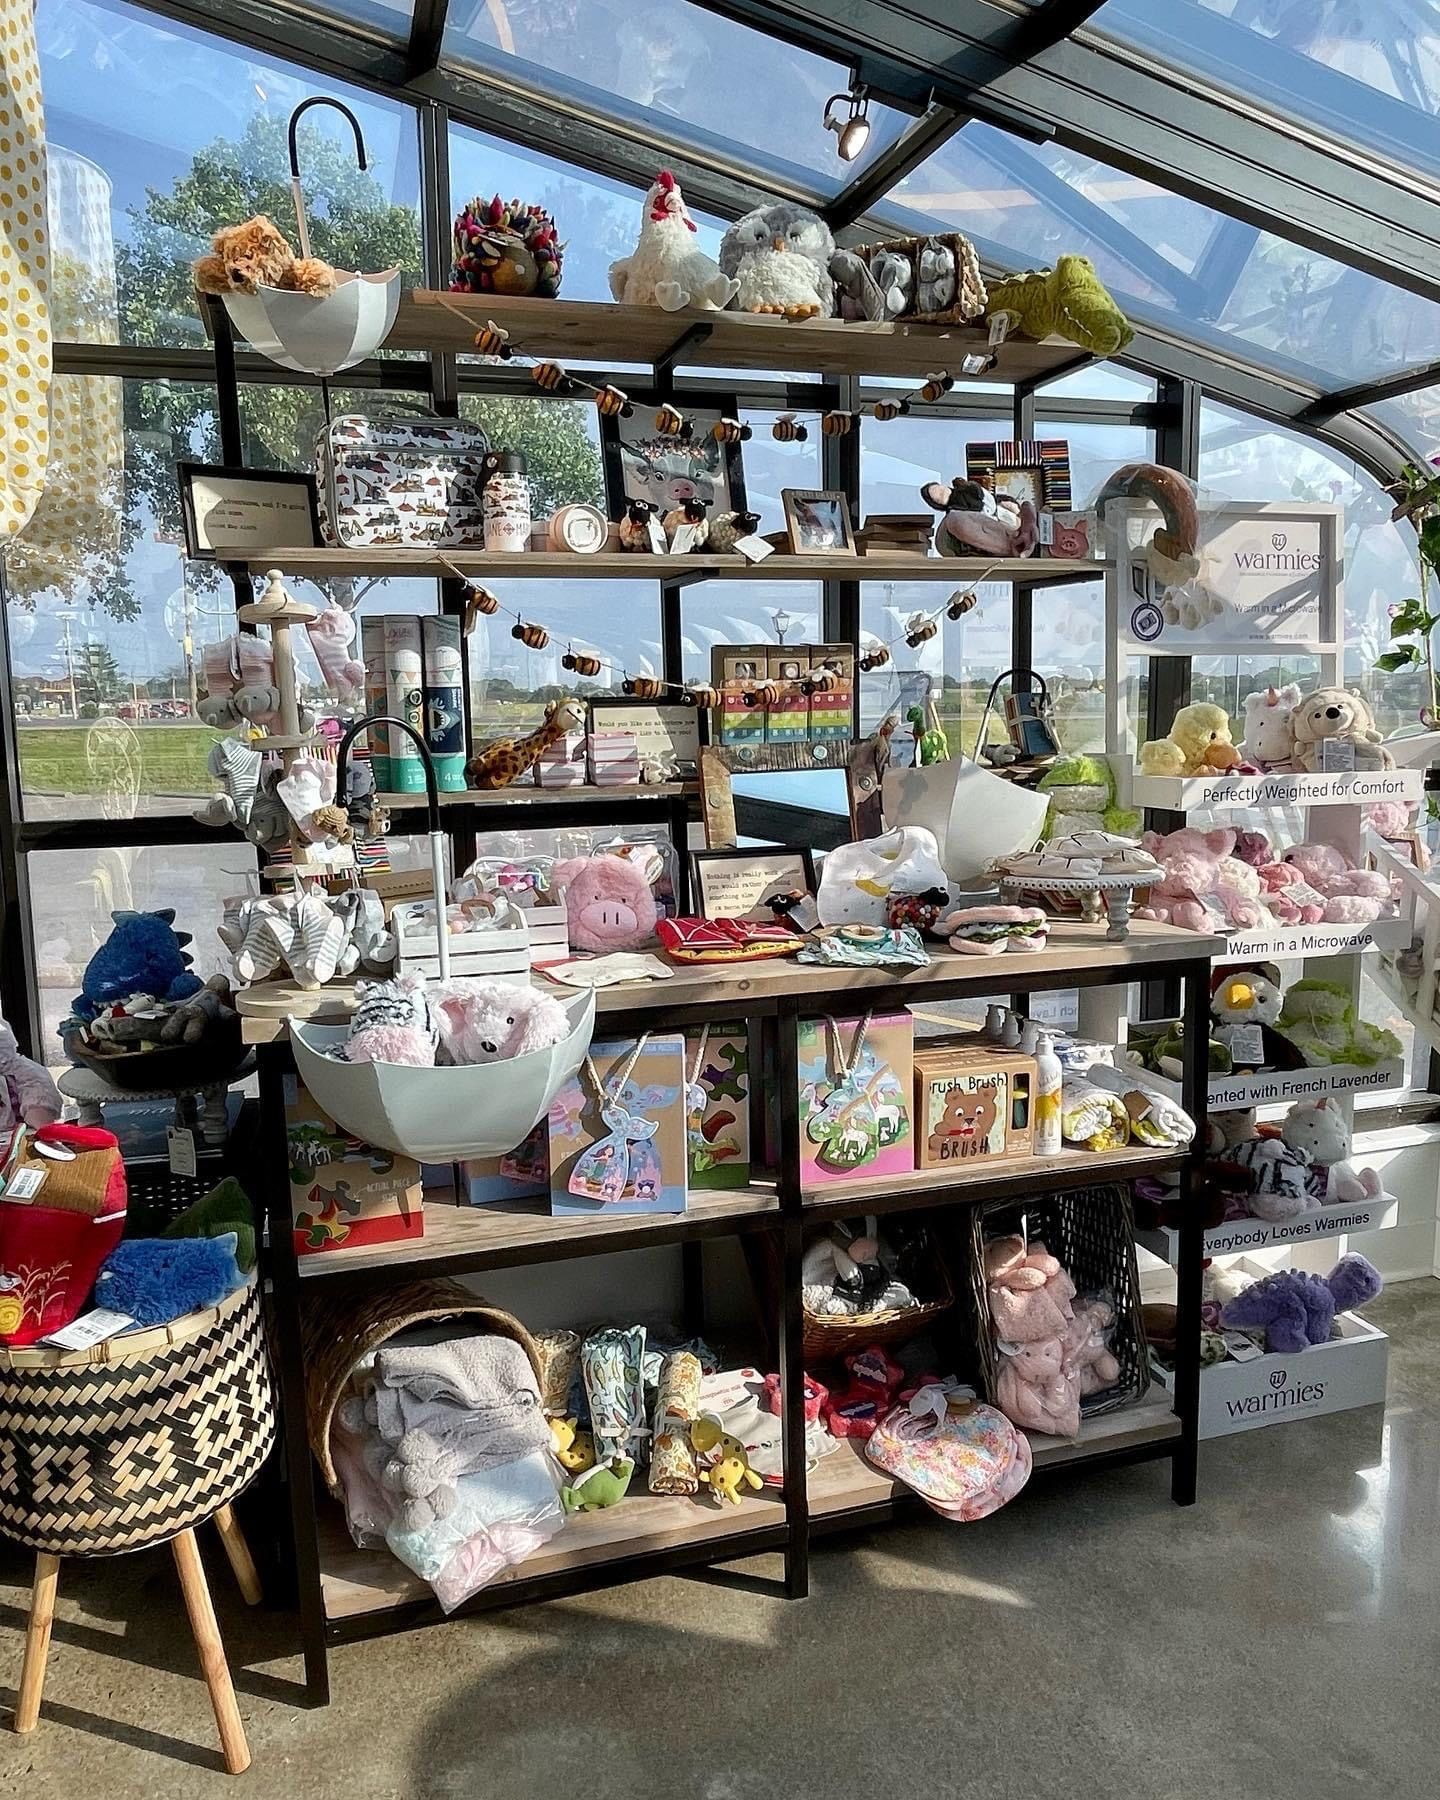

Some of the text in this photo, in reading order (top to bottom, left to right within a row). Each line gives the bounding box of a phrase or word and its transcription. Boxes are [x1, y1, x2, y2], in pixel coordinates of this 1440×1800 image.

[1234, 548, 1322, 570] warmies
[1203, 780, 1405, 803] Perfectly Weighted for Comfort
[1229, 933, 1373, 956] Warm in a Microwave
[930, 1076, 961, 1094] rush
[1207, 1072, 1391, 1105] ented with French Lavender
[940, 1136, 989, 1159] BRUSH
[1272, 1222, 1311, 1240] Loves
[1315, 1213, 1370, 1232] Warmies
[1225, 1381, 1324, 1417] warmies
